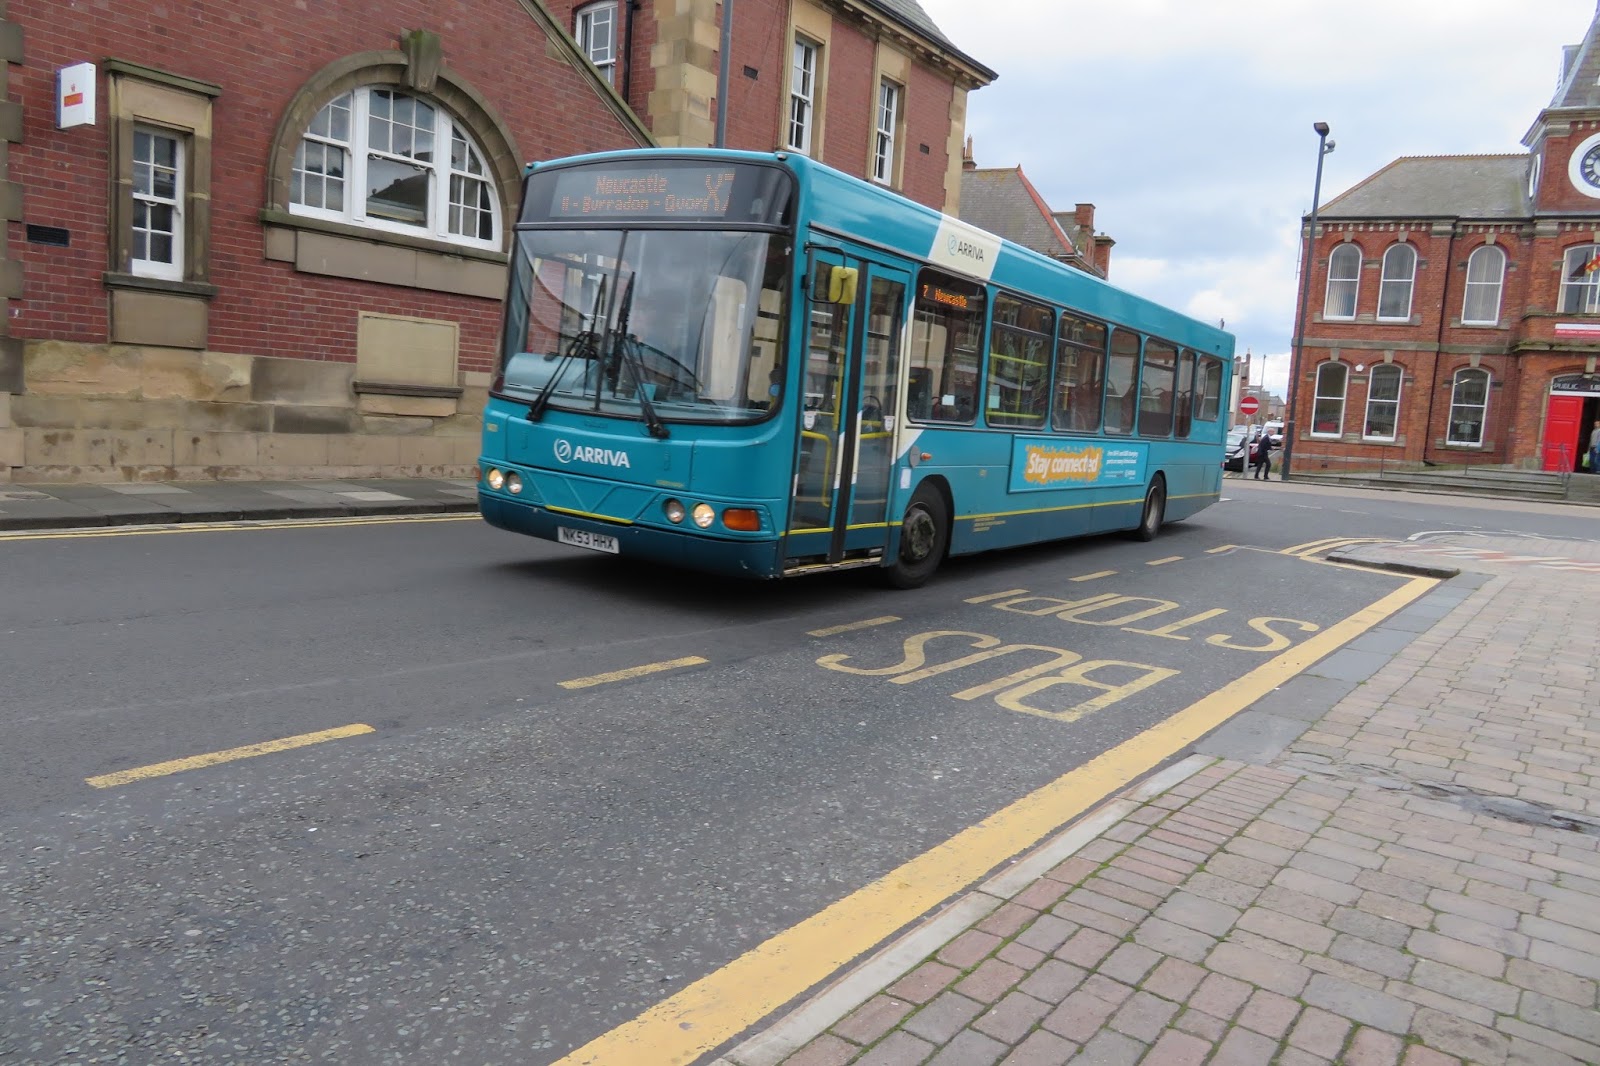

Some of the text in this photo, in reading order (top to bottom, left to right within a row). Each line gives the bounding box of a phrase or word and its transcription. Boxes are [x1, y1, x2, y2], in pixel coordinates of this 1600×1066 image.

[596, 174, 668, 195] Newcastle
[582, 194, 650, 213] Burradon
[957, 241, 983, 262] ARRIVA
[935, 288, 967, 307] Newcastle
[573, 445, 632, 469] ARRIVA
[1027, 452, 1052, 479] Stay
[562, 528, 615, 551] NK53 HHX
[993, 593, 1320, 652] STOP
[815, 629, 1182, 723] BUS
